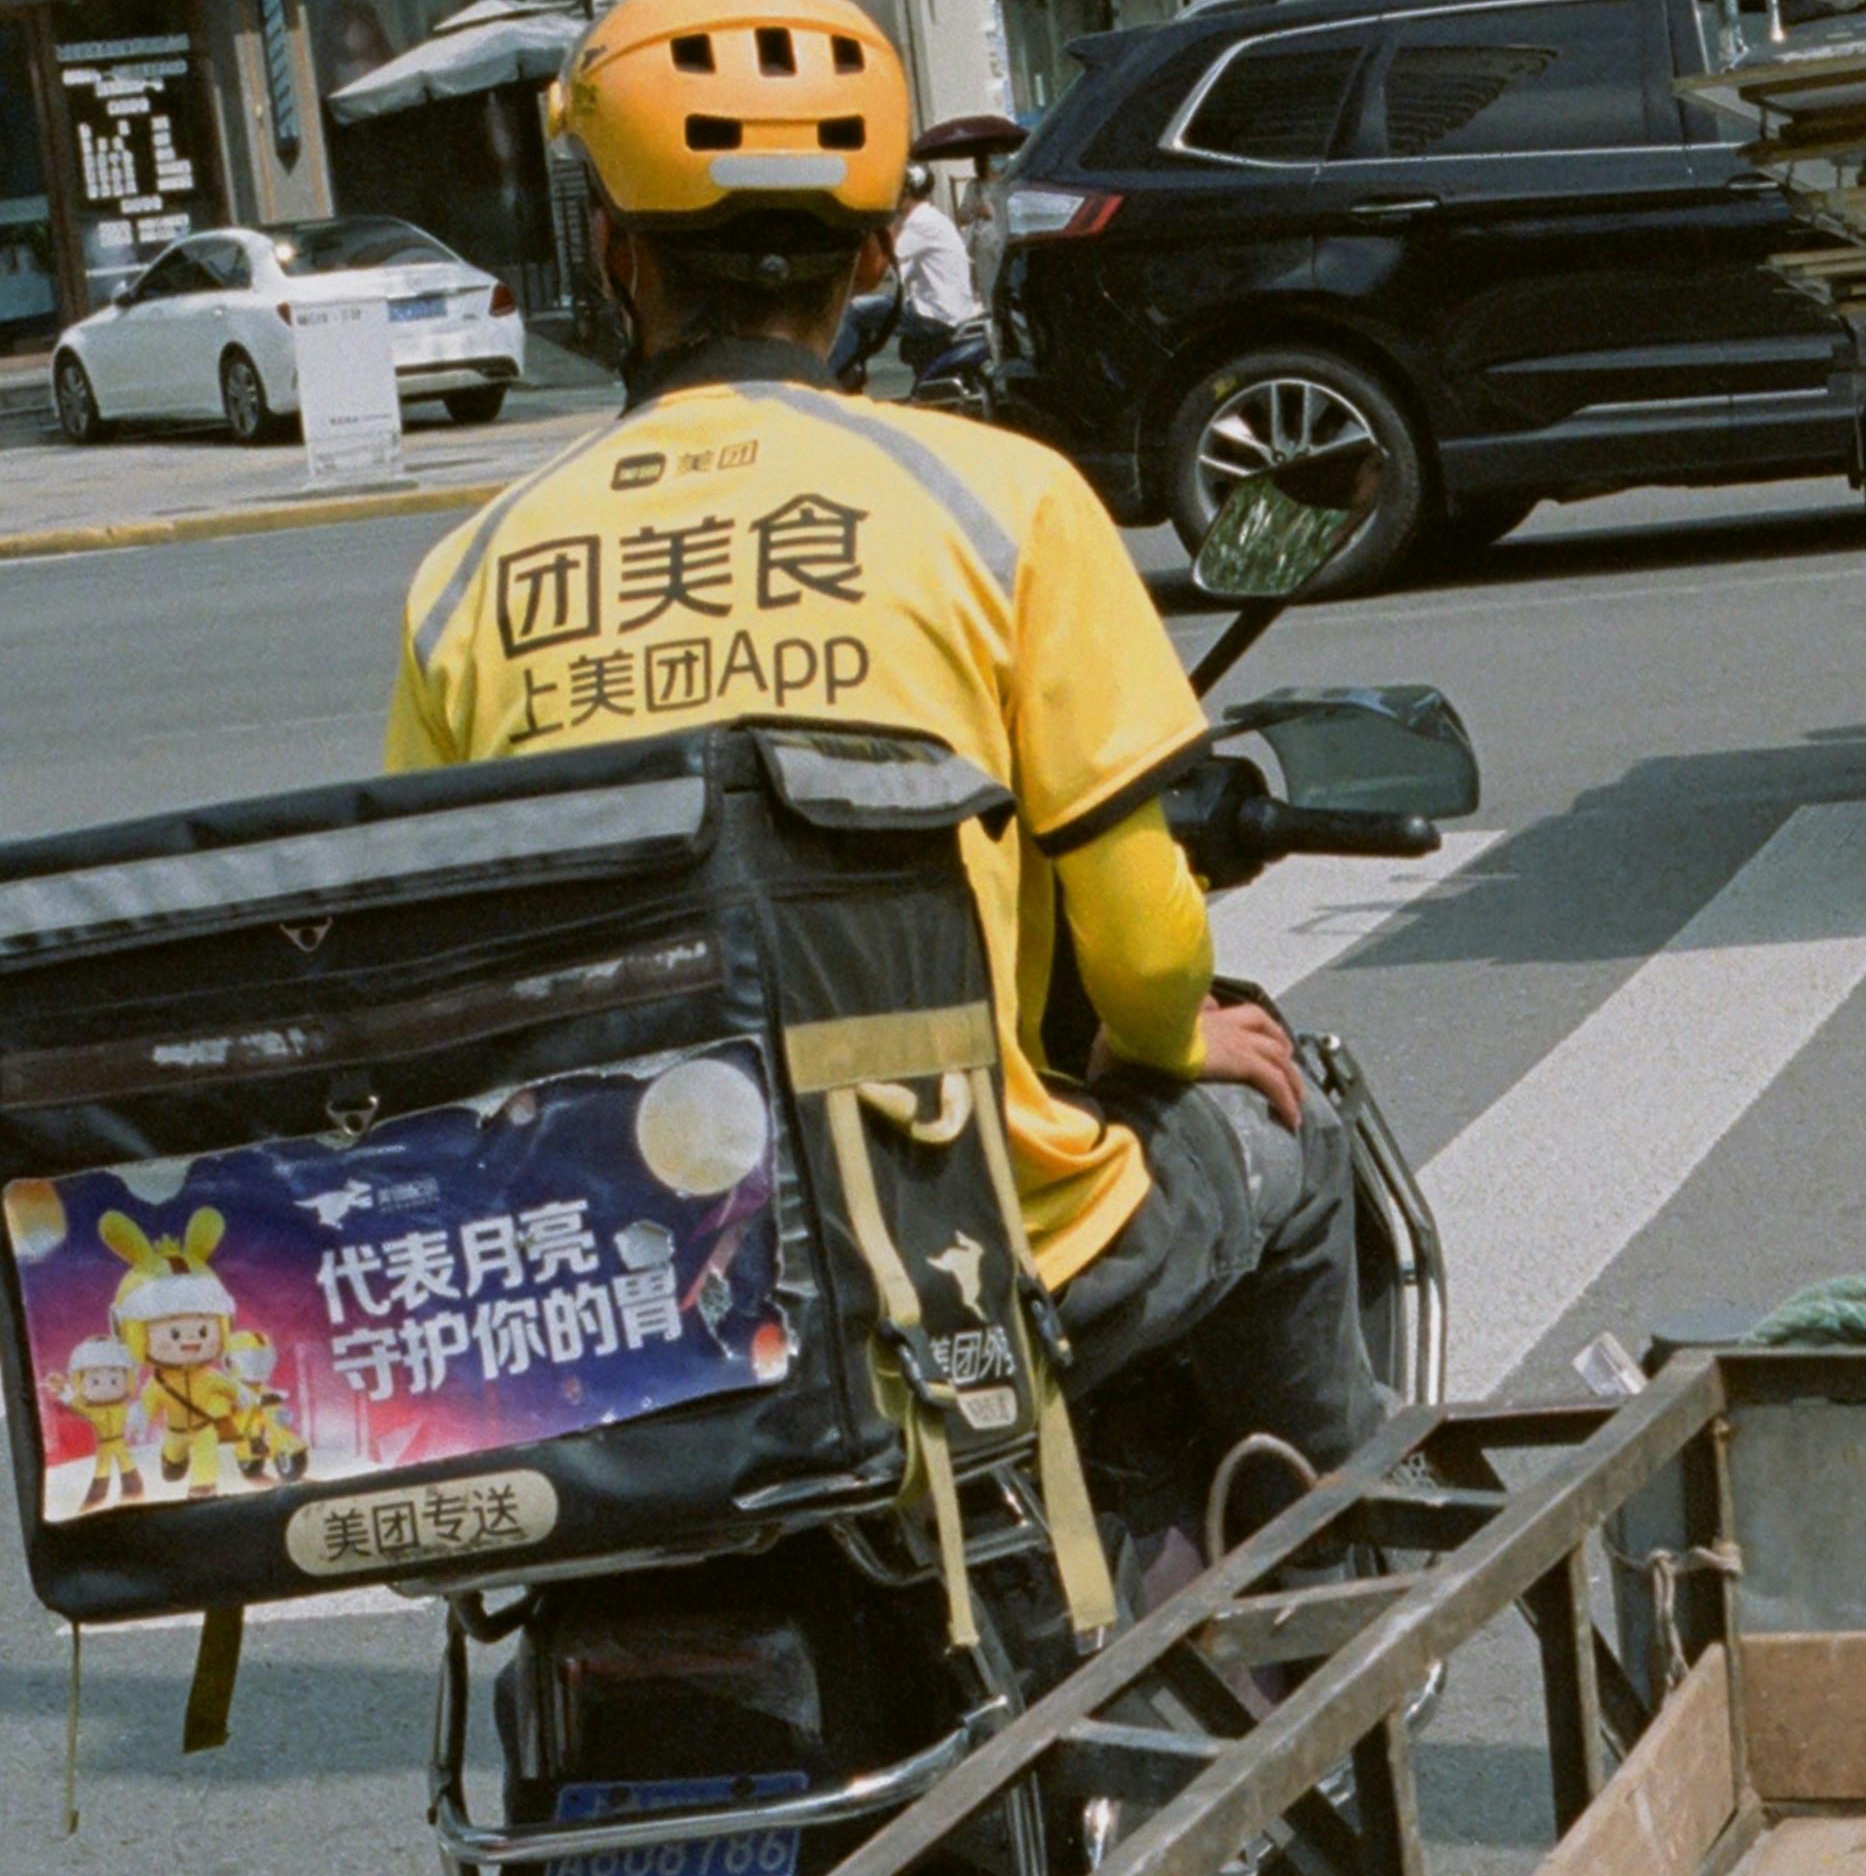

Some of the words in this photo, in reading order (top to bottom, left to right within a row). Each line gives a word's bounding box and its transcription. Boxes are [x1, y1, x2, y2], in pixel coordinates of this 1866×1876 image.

[497, 492, 869, 659] 团美食
[509, 630, 870, 744] 上美团App
[316, 1198, 599, 1324] 代表月亮
[332, 1262, 683, 1402] 守护你的胃
[324, 1484, 528, 1562] 美团专送
